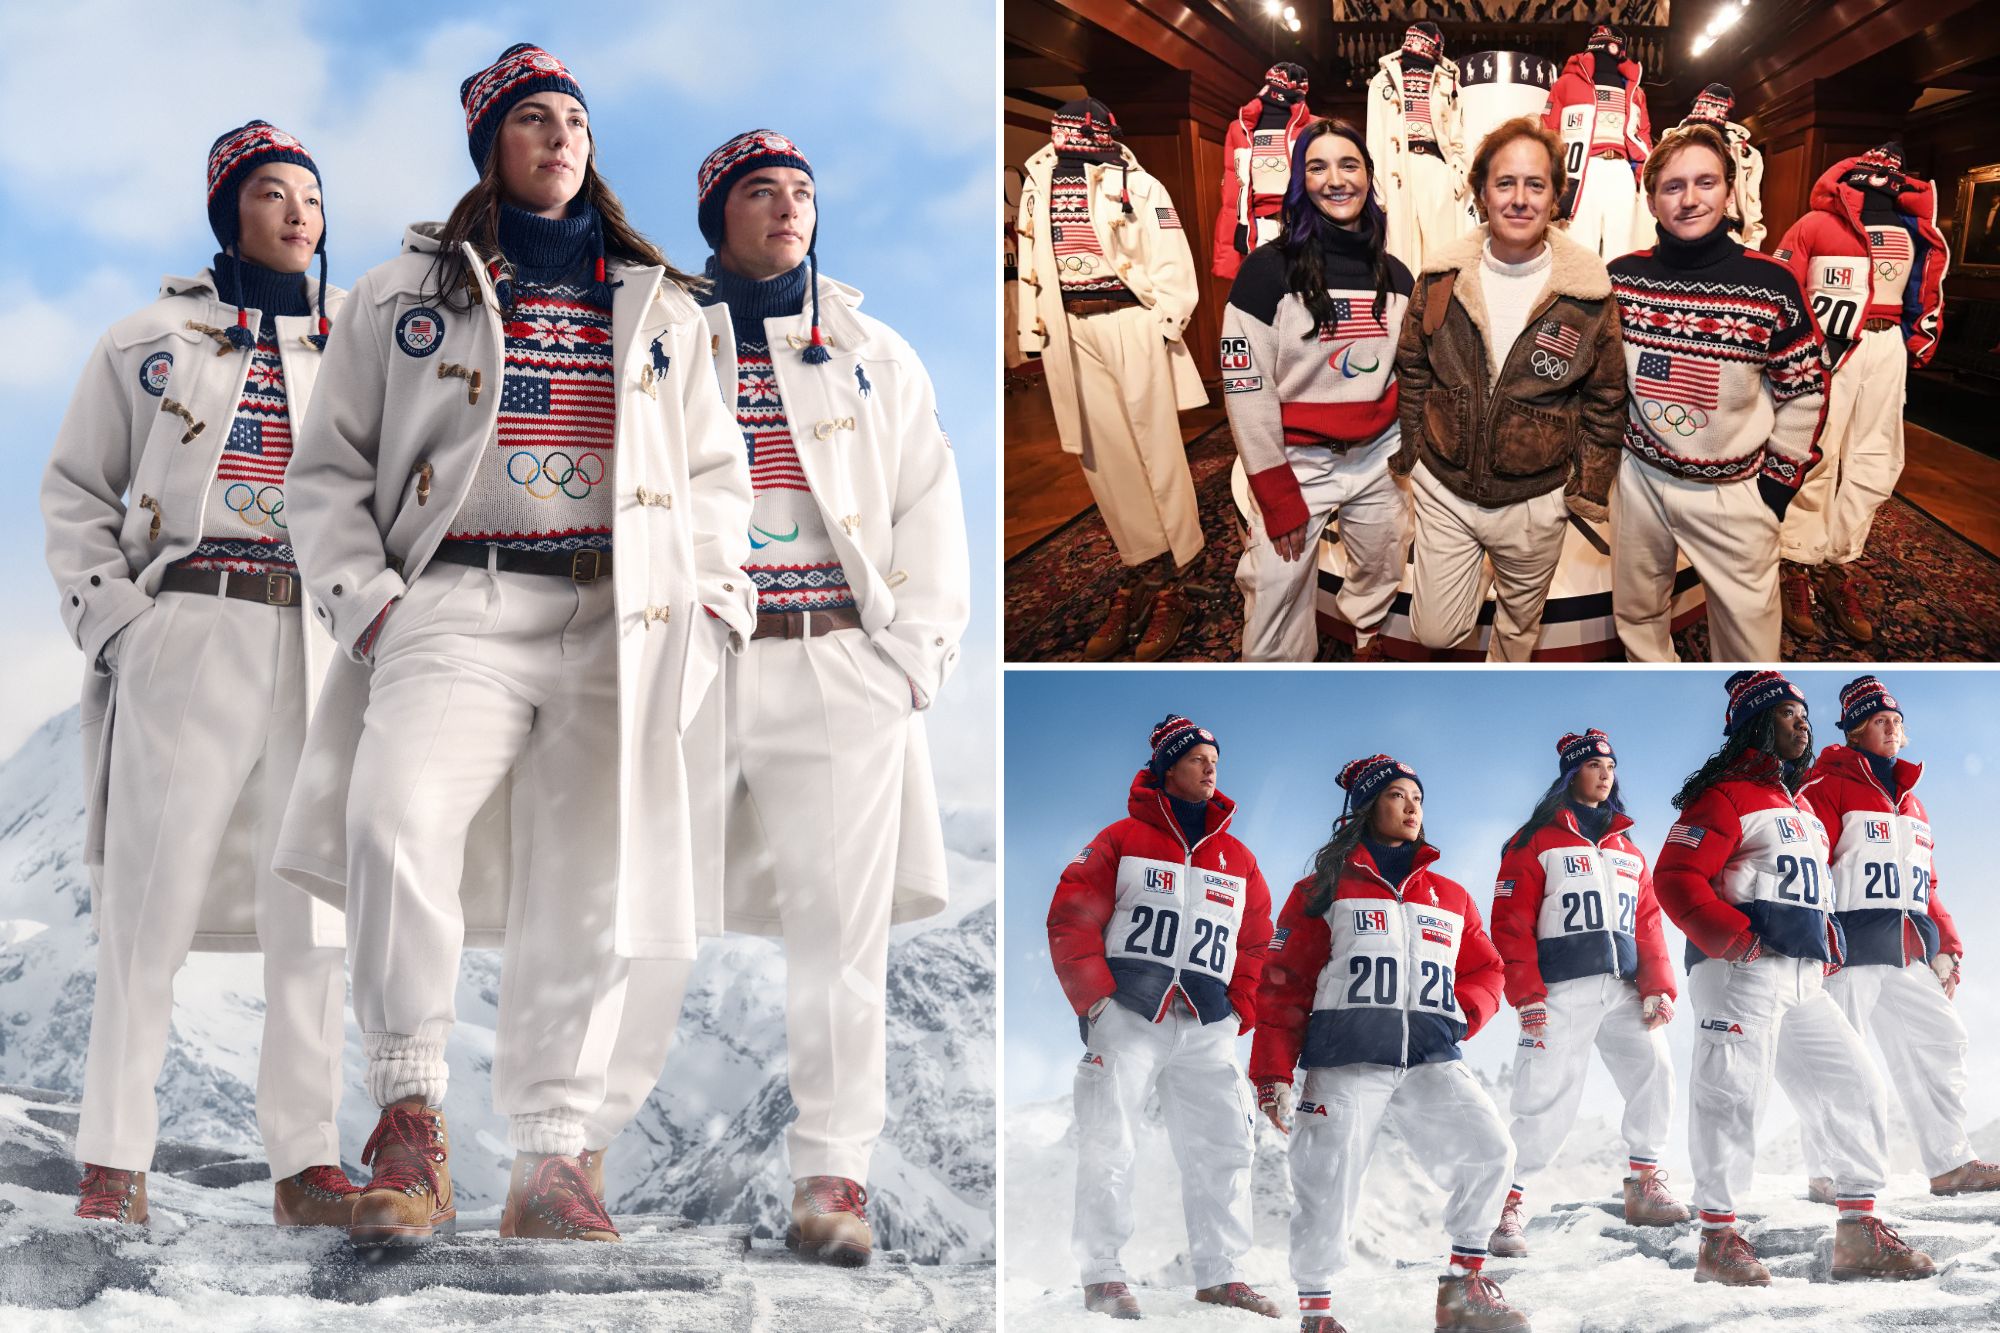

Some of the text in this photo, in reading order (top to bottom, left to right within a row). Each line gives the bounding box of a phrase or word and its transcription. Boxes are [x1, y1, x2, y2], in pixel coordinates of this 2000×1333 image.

[1567, 112, 1584, 127] USA
[1567, 141, 1584, 173] 0
[1825, 269, 1852, 285] USA
[1813, 295, 1857, 338] 20
[1224, 379, 1246, 388] SA
[1747, 686, 1784, 709] TEAM
[1850, 700, 1877, 719] TEAM
[1166, 733, 1195, 757] TEAM
[1565, 745, 1591, 761] TEAM
[1360, 767, 1392, 793] TEAM
[1777, 818, 1805, 839] USA
[1866, 821, 1889, 839] USA
[1565, 856, 1591, 874] USA
[1146, 869, 1174, 891] USA
[1776, 854, 1820, 905] 20
[1864, 861, 1901, 899] 20
[1355, 911, 1386, 930] USA
[1562, 890, 1604, 933] 20
[1124, 905, 1229, 974] 20 26
[1347, 955, 1456, 1013] 20 26
[1700, 1019, 1743, 1035] USA
[1081, 1052, 1104, 1067] SA
